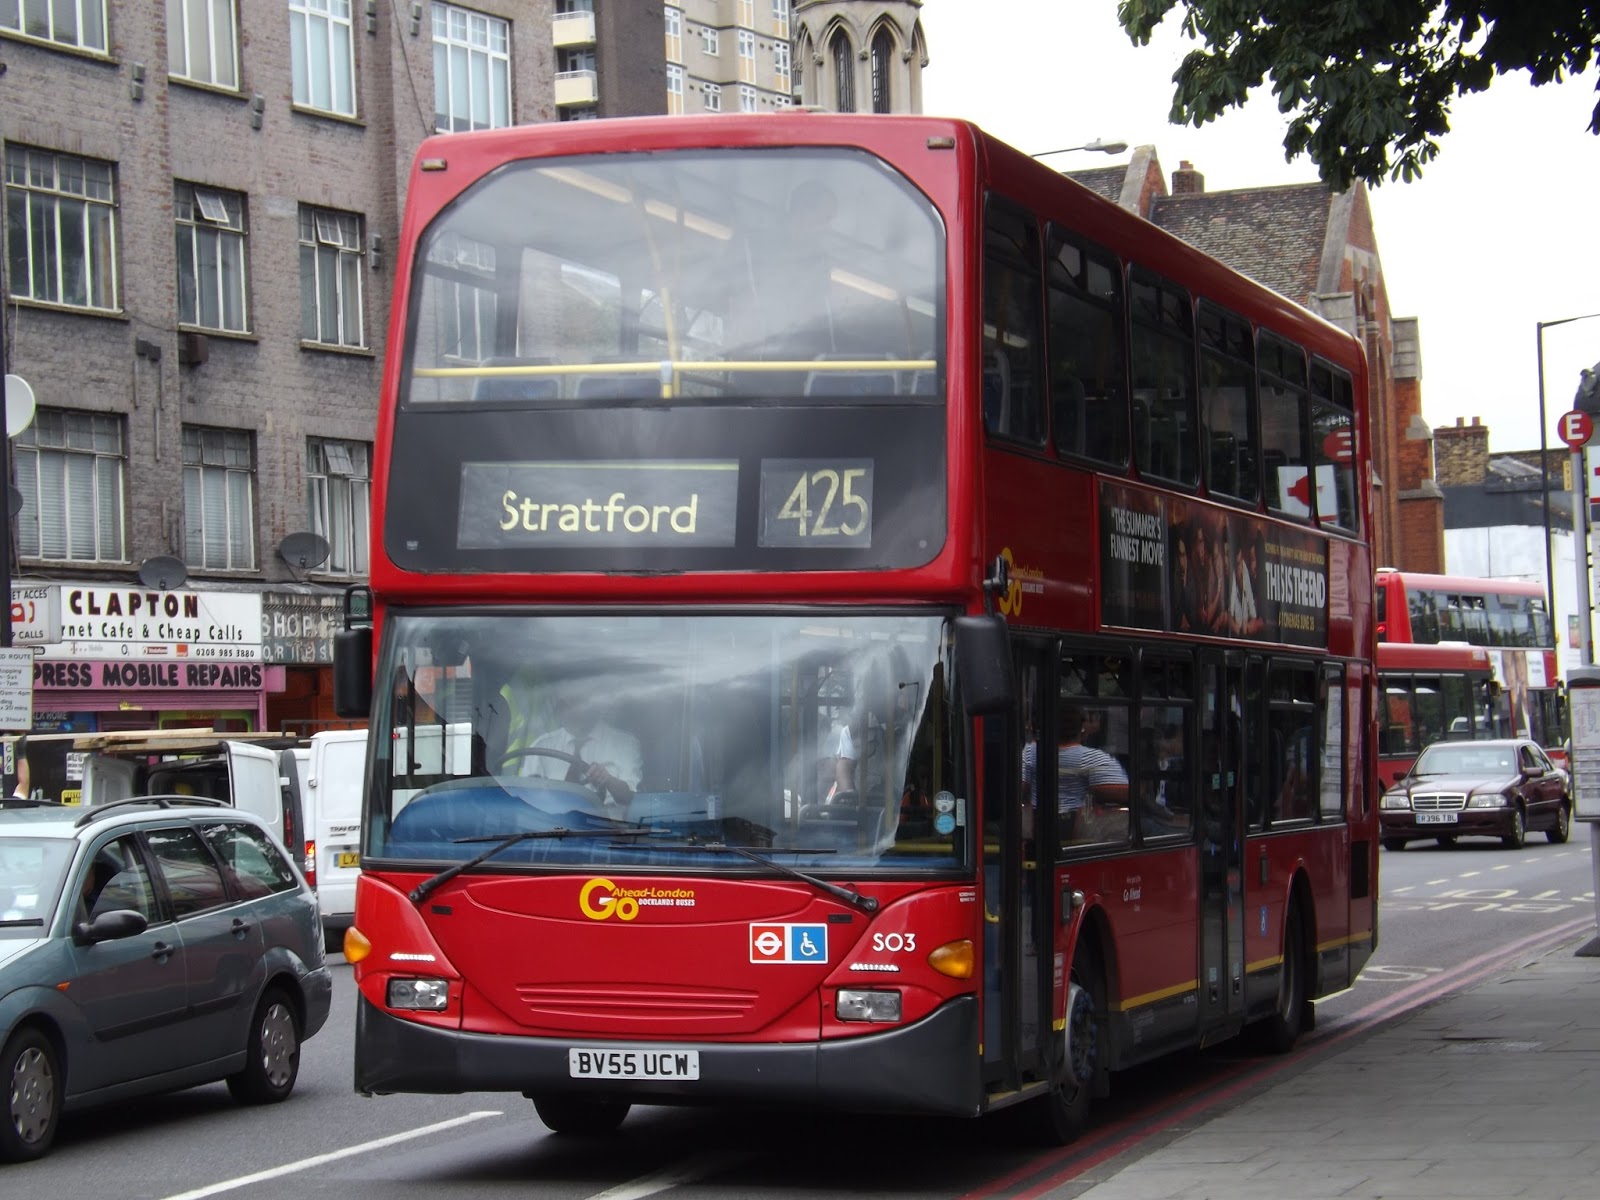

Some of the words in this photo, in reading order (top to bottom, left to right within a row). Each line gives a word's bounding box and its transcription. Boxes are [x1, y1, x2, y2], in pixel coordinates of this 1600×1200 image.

[1567, 415, 1584, 440] E
[499, 490, 698, 534] Stratford
[776, 468, 868, 537] 425
[69, 590, 199, 619] CLAPTON
[18, 630, 44, 639] CALLS
[101, 623, 134, 639] Cafe
[142, 623, 151, 638] &
[158, 624, 201, 643] Cheap
[208, 625, 243, 641] Calls
[196, 648, 215, 656] 0208
[219, 649, 233, 657] 985
[102, 663, 179, 687] MOBILE
[186, 664, 262, 687] REPAIRS
[579, 877, 639, 921] Go
[612, 887, 695, 898] Ahead-London
[638, 898, 674, 906] DOCKLANDS
[675, 899, 695, 907] BUSES
[872, 932, 916, 952] SO3
[578, 1052, 636, 1075] BV55
[643, 1053, 688, 1076] UCW
